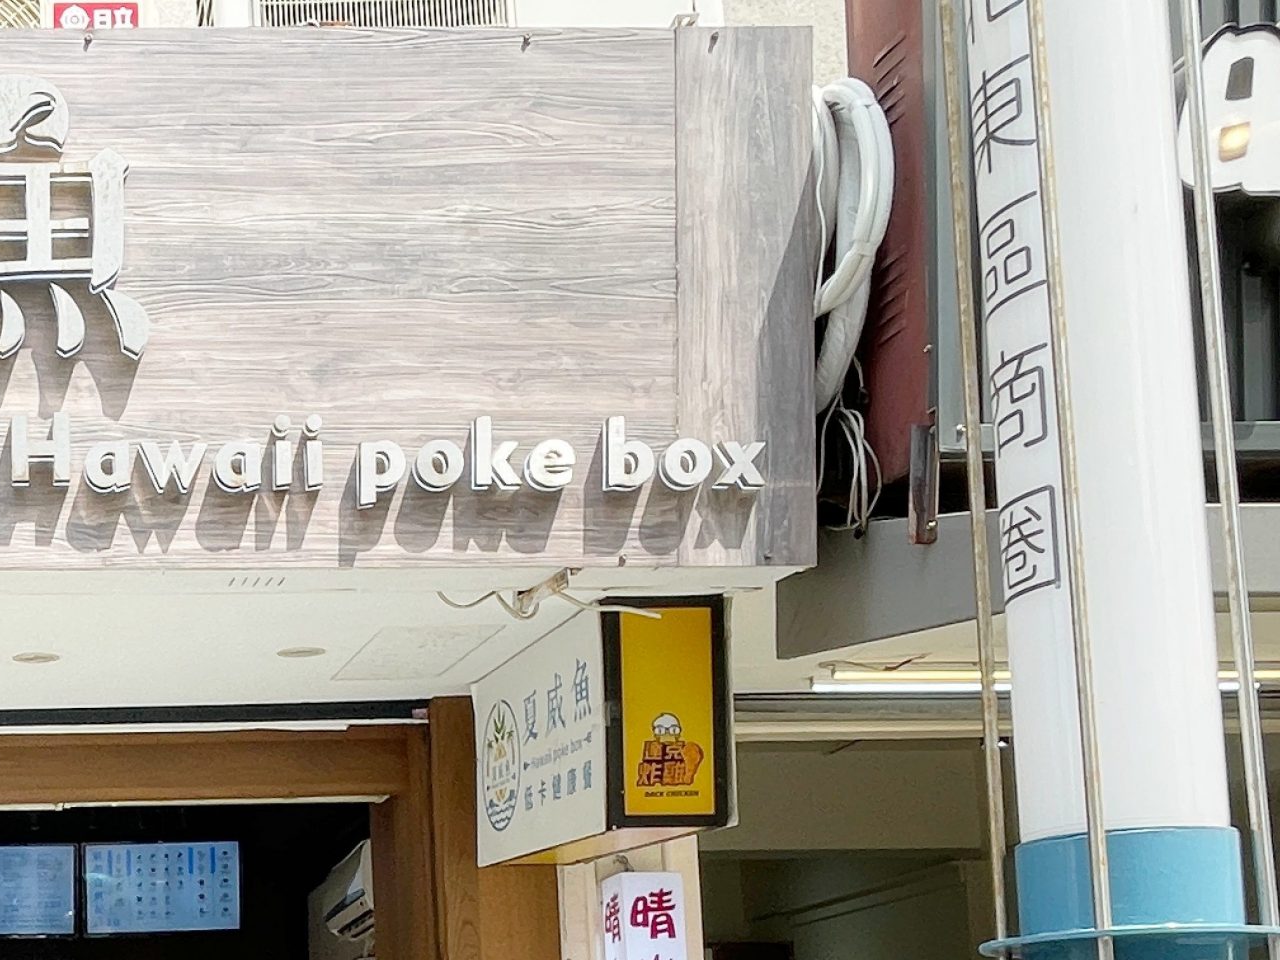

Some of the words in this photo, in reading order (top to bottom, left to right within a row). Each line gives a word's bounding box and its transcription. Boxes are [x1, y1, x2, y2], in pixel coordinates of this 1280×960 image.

[93, 7, 134, 28] 日立
[967, 0, 1062, 608] 東區商圈
[11, 412, 323, 493] Hawaii
[355, 415, 577, 509] poke
[601, 415, 766, 491] box
[523, 658, 592, 746] 夏威魚
